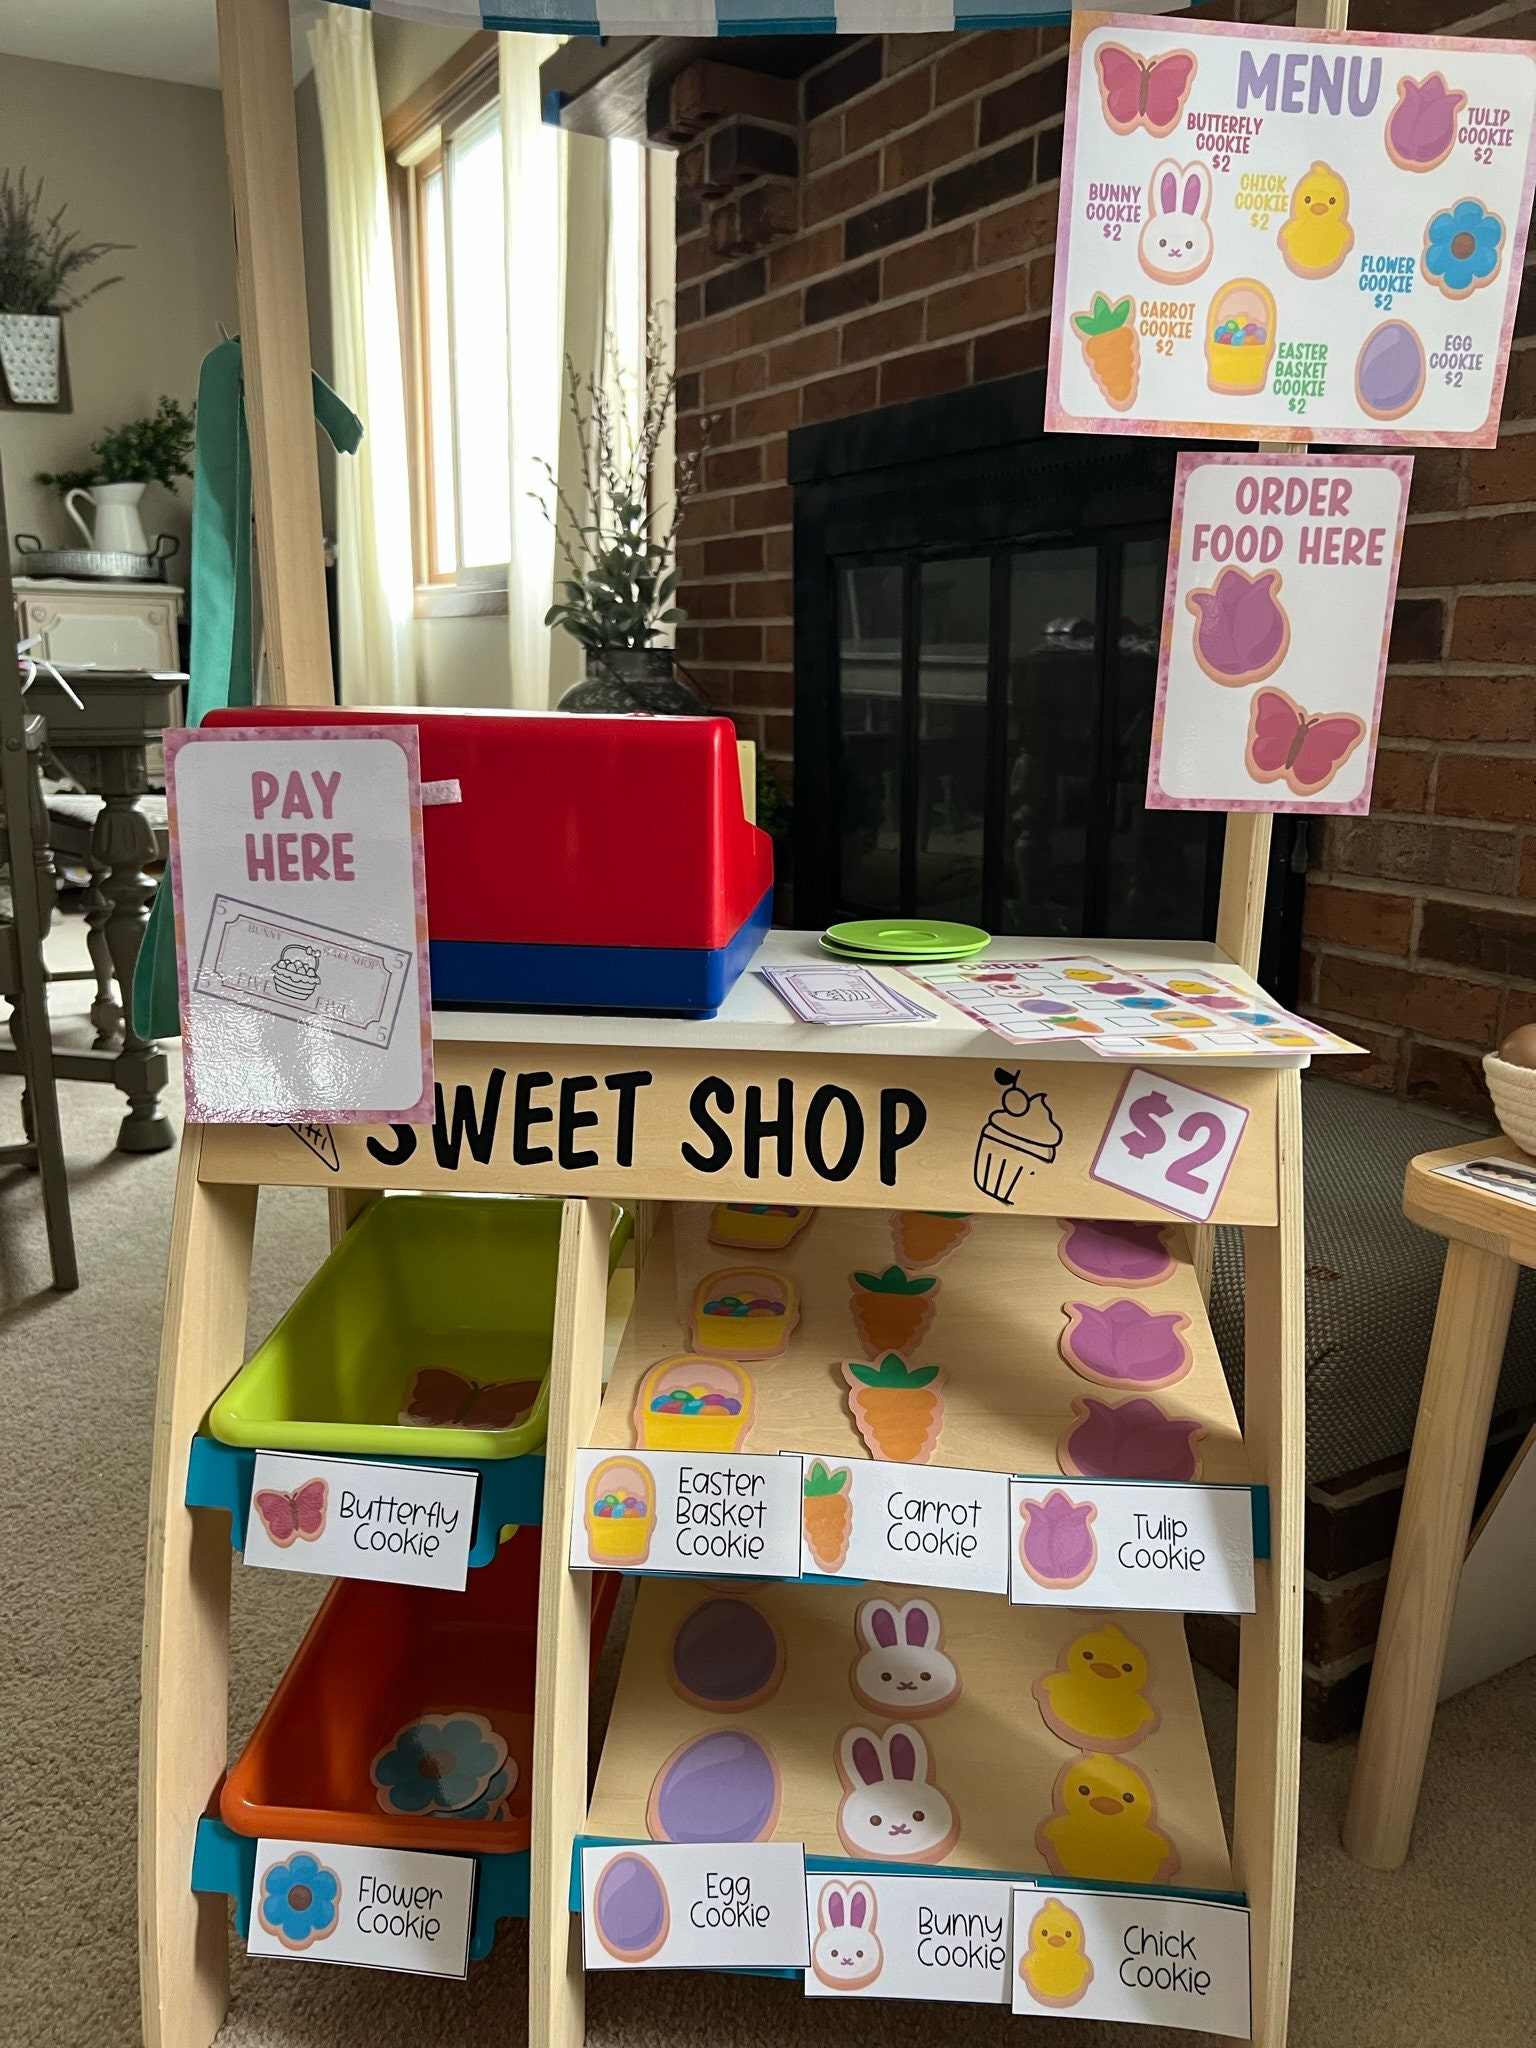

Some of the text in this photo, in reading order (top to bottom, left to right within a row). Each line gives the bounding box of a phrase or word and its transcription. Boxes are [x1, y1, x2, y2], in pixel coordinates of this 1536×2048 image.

[1236, 50, 1383, 117] MENU
[1187, 113, 1263, 136] BUTTERFLY
[1467, 108, 1511, 126] TULIP
[1195, 134, 1250, 154] COOKIE
[1458, 128, 1514, 146] COOKIE
[1212, 155, 1231, 172] $2
[1474, 147, 1493, 164] $2
[1088, 183, 1141, 203] BUNNY
[1240, 173, 1287, 193] CHICK
[1234, 193, 1289, 212] COOKIE
[1086, 204, 1141, 223] COOKIE
[1250, 213, 1270, 230] $2
[1103, 224, 1122, 241] $2
[1361, 255, 1415, 275] FLOWER
[1358, 274, 1413, 293] COOKIE
[1140, 301, 1196, 320] CARROT
[1374, 294, 1393, 311] $2
[1140, 319, 1192, 339] COOKIE
[1156, 339, 1174, 356] $2
[1278, 342, 1328, 361] EASTER
[1444, 335, 1472, 353] EGG
[1275, 360, 1327, 379] BASKET
[1430, 352, 1483, 371] COOKIE
[1273, 379, 1325, 397] COOKIE
[1445, 370, 1463, 388] $2
[1288, 397, 1306, 414] $2
[1235, 476, 1353, 517] ORDER
[1192, 524, 1386, 566] FOOD HERE
[251, 770, 341, 820] PAY
[245, 833, 356, 882] HERE
[217, 900, 230, 915] 5
[392, 953, 405, 970] 5
[957, 962, 1044, 971] ORDER
[376, 1026, 388, 1042] 5
[681, 1075, 927, 1186] SHOP
[1120, 1090, 1226, 1195] $2
[679, 1467, 765, 1496] Easter
[340, 1491, 459, 1533] Butterfly
[676, 1497, 767, 1528] Basket
[887, 1492, 982, 1528] Carrot
[1133, 1513, 1188, 1546] Tulip
[353, 1523, 440, 1557] Cookie
[676, 1528, 765, 1560] Cookie
[887, 1523, 978, 1558] Cookie
[1118, 1542, 1206, 1571] Cookie
[359, 1876, 443, 1910] Flower
[706, 1872, 751, 1905] Egg
[357, 1905, 441, 1941] Cookie
[690, 1901, 770, 1928] Cookie
[918, 1906, 1003, 1942] Bunny
[1124, 1925, 1196, 1960] Chick
[917, 1937, 1006, 1970] Cookie
[1119, 1957, 1211, 1995] Cookie
